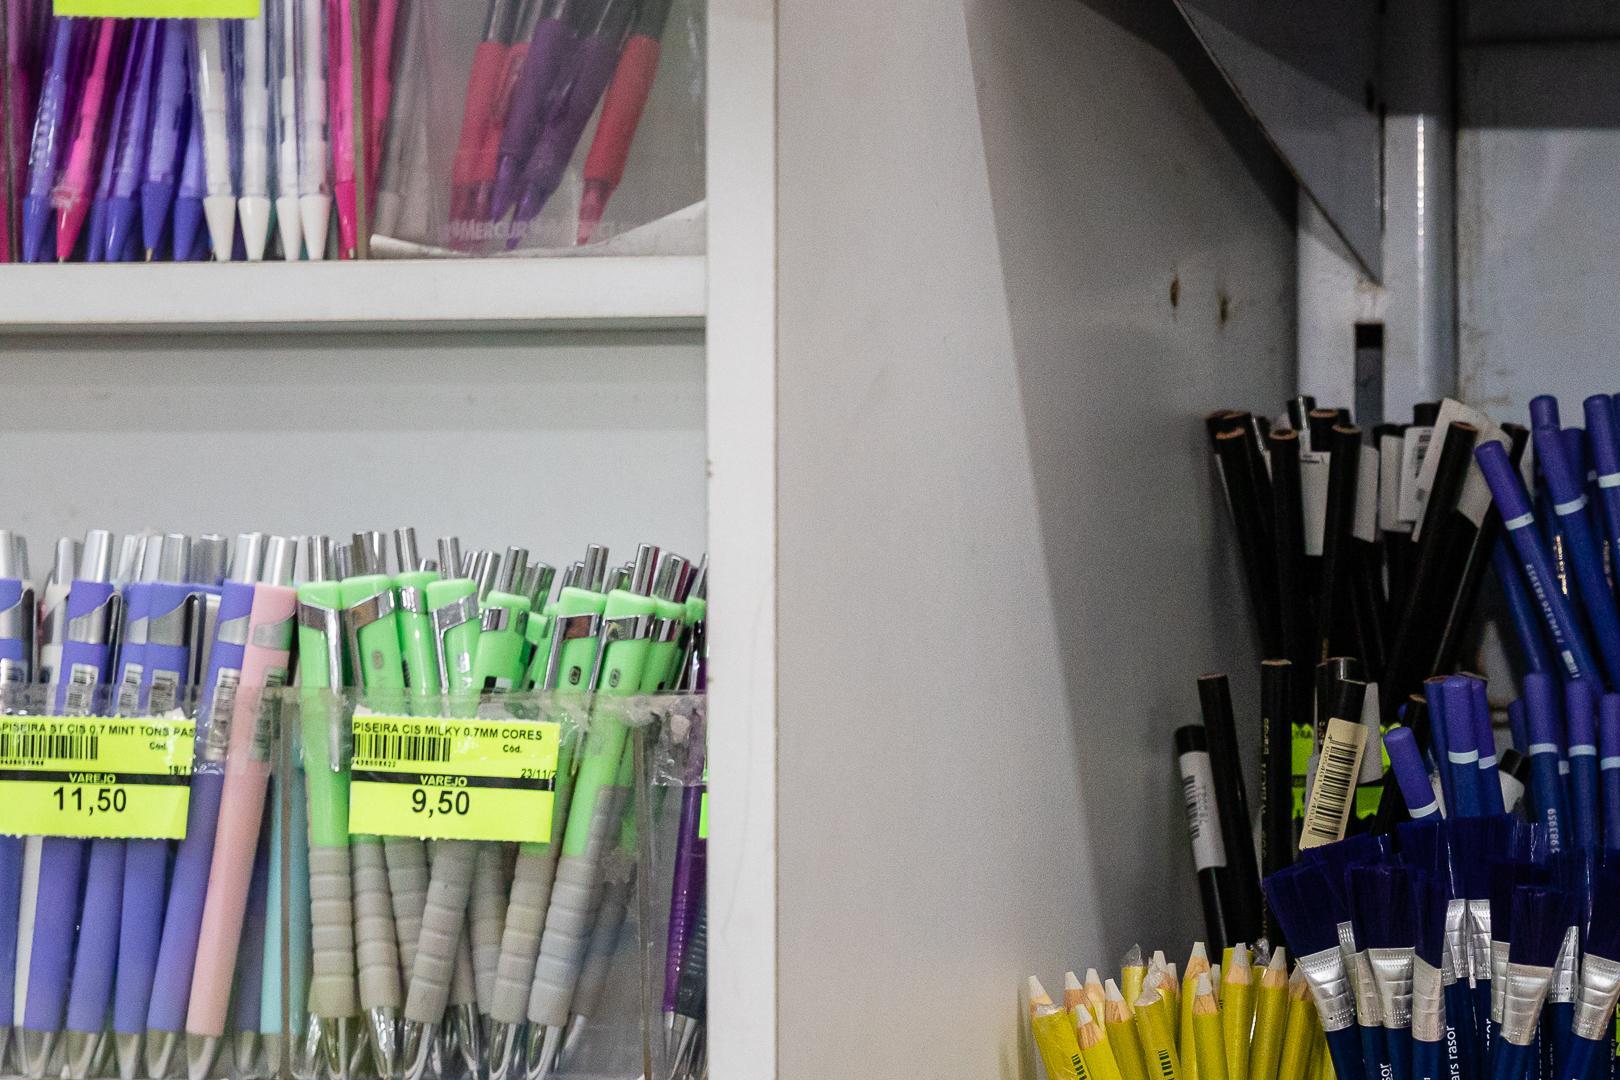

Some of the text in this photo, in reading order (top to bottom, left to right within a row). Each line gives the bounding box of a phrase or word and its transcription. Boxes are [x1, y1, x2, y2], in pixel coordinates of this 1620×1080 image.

[109, 726, 135, 736] MINT
[353, 722, 399, 733] PISEIRA
[402, 724, 421, 735] CIS
[425, 725, 460, 737] MILKY
[502, 729, 542, 741] CORES
[69, 773, 116, 784] VAREJO
[420, 775, 468, 787] VAREJO
[53, 786, 127, 816] 11,50
[411, 788, 470, 818] 9,50
